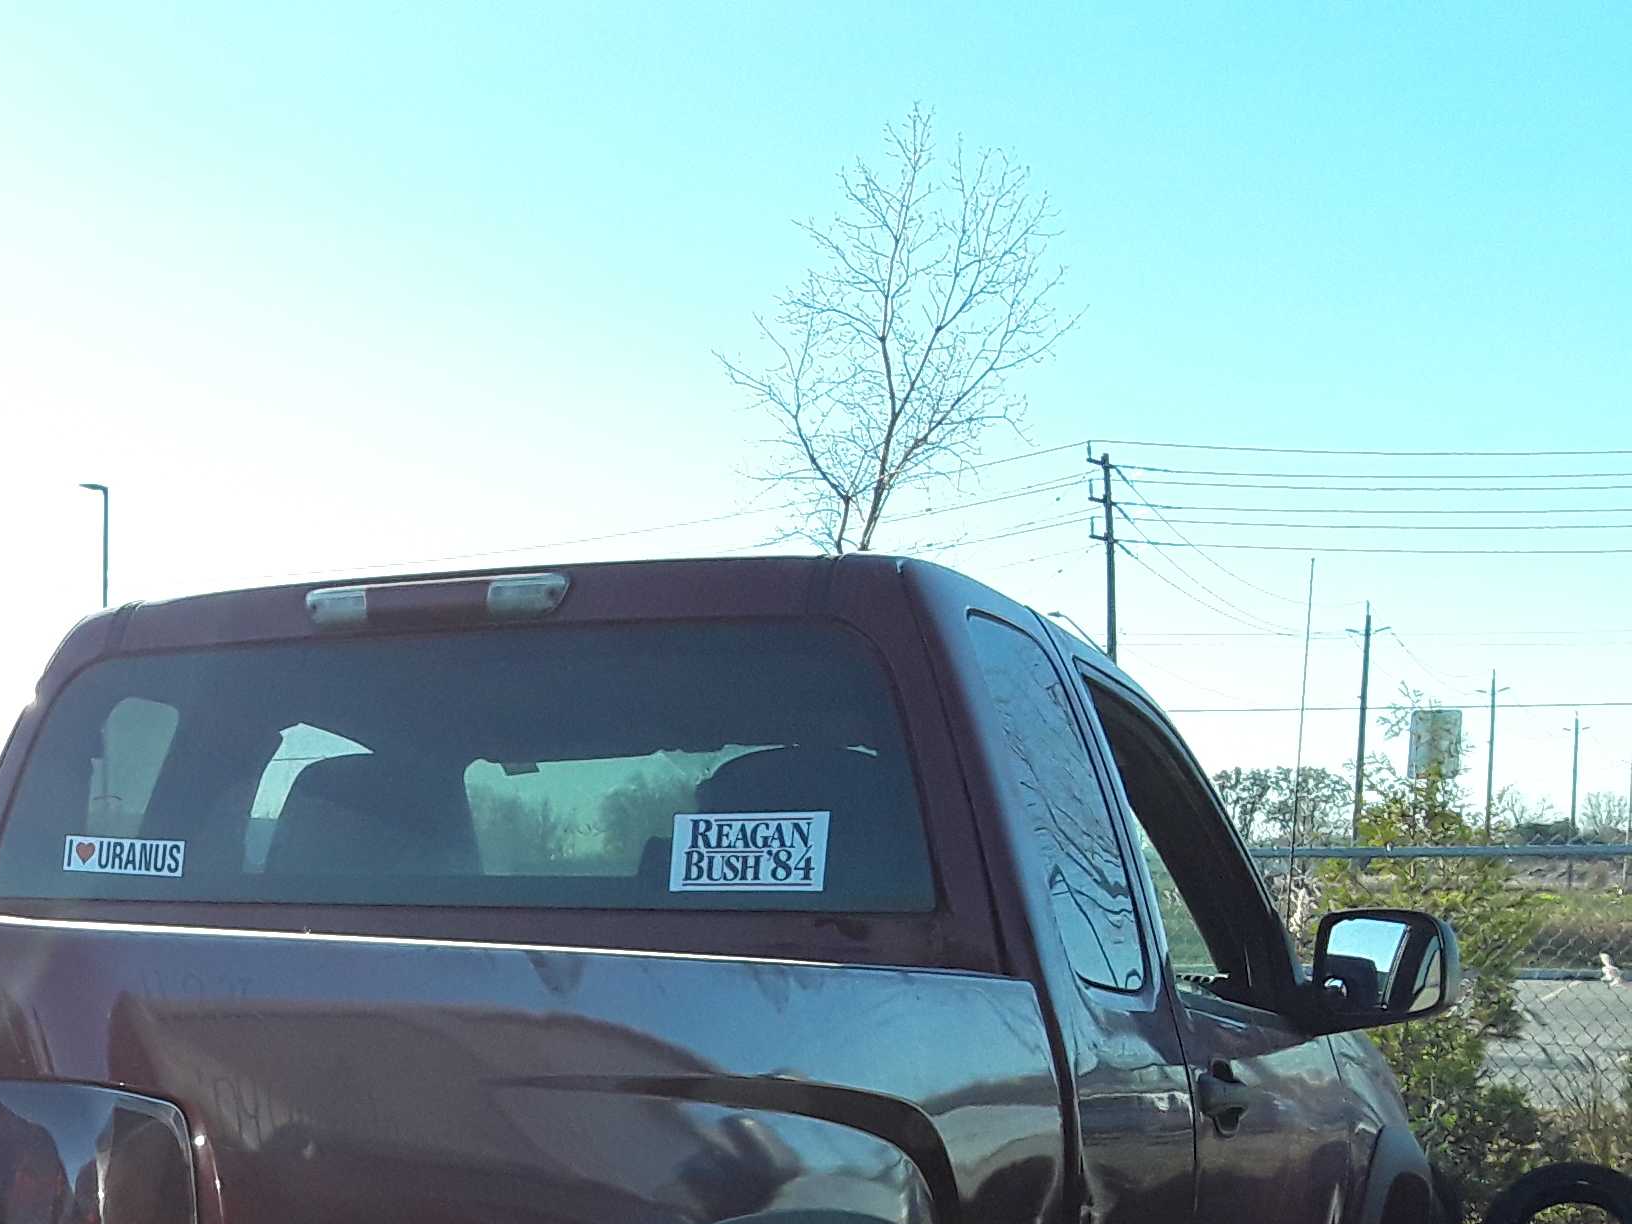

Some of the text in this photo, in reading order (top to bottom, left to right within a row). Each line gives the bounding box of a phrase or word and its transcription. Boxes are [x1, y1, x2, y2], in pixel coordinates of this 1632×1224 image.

[688, 818, 812, 849] REAGAN
[67, 839, 181, 873] I URANUS
[682, 849, 763, 882] BUSH
